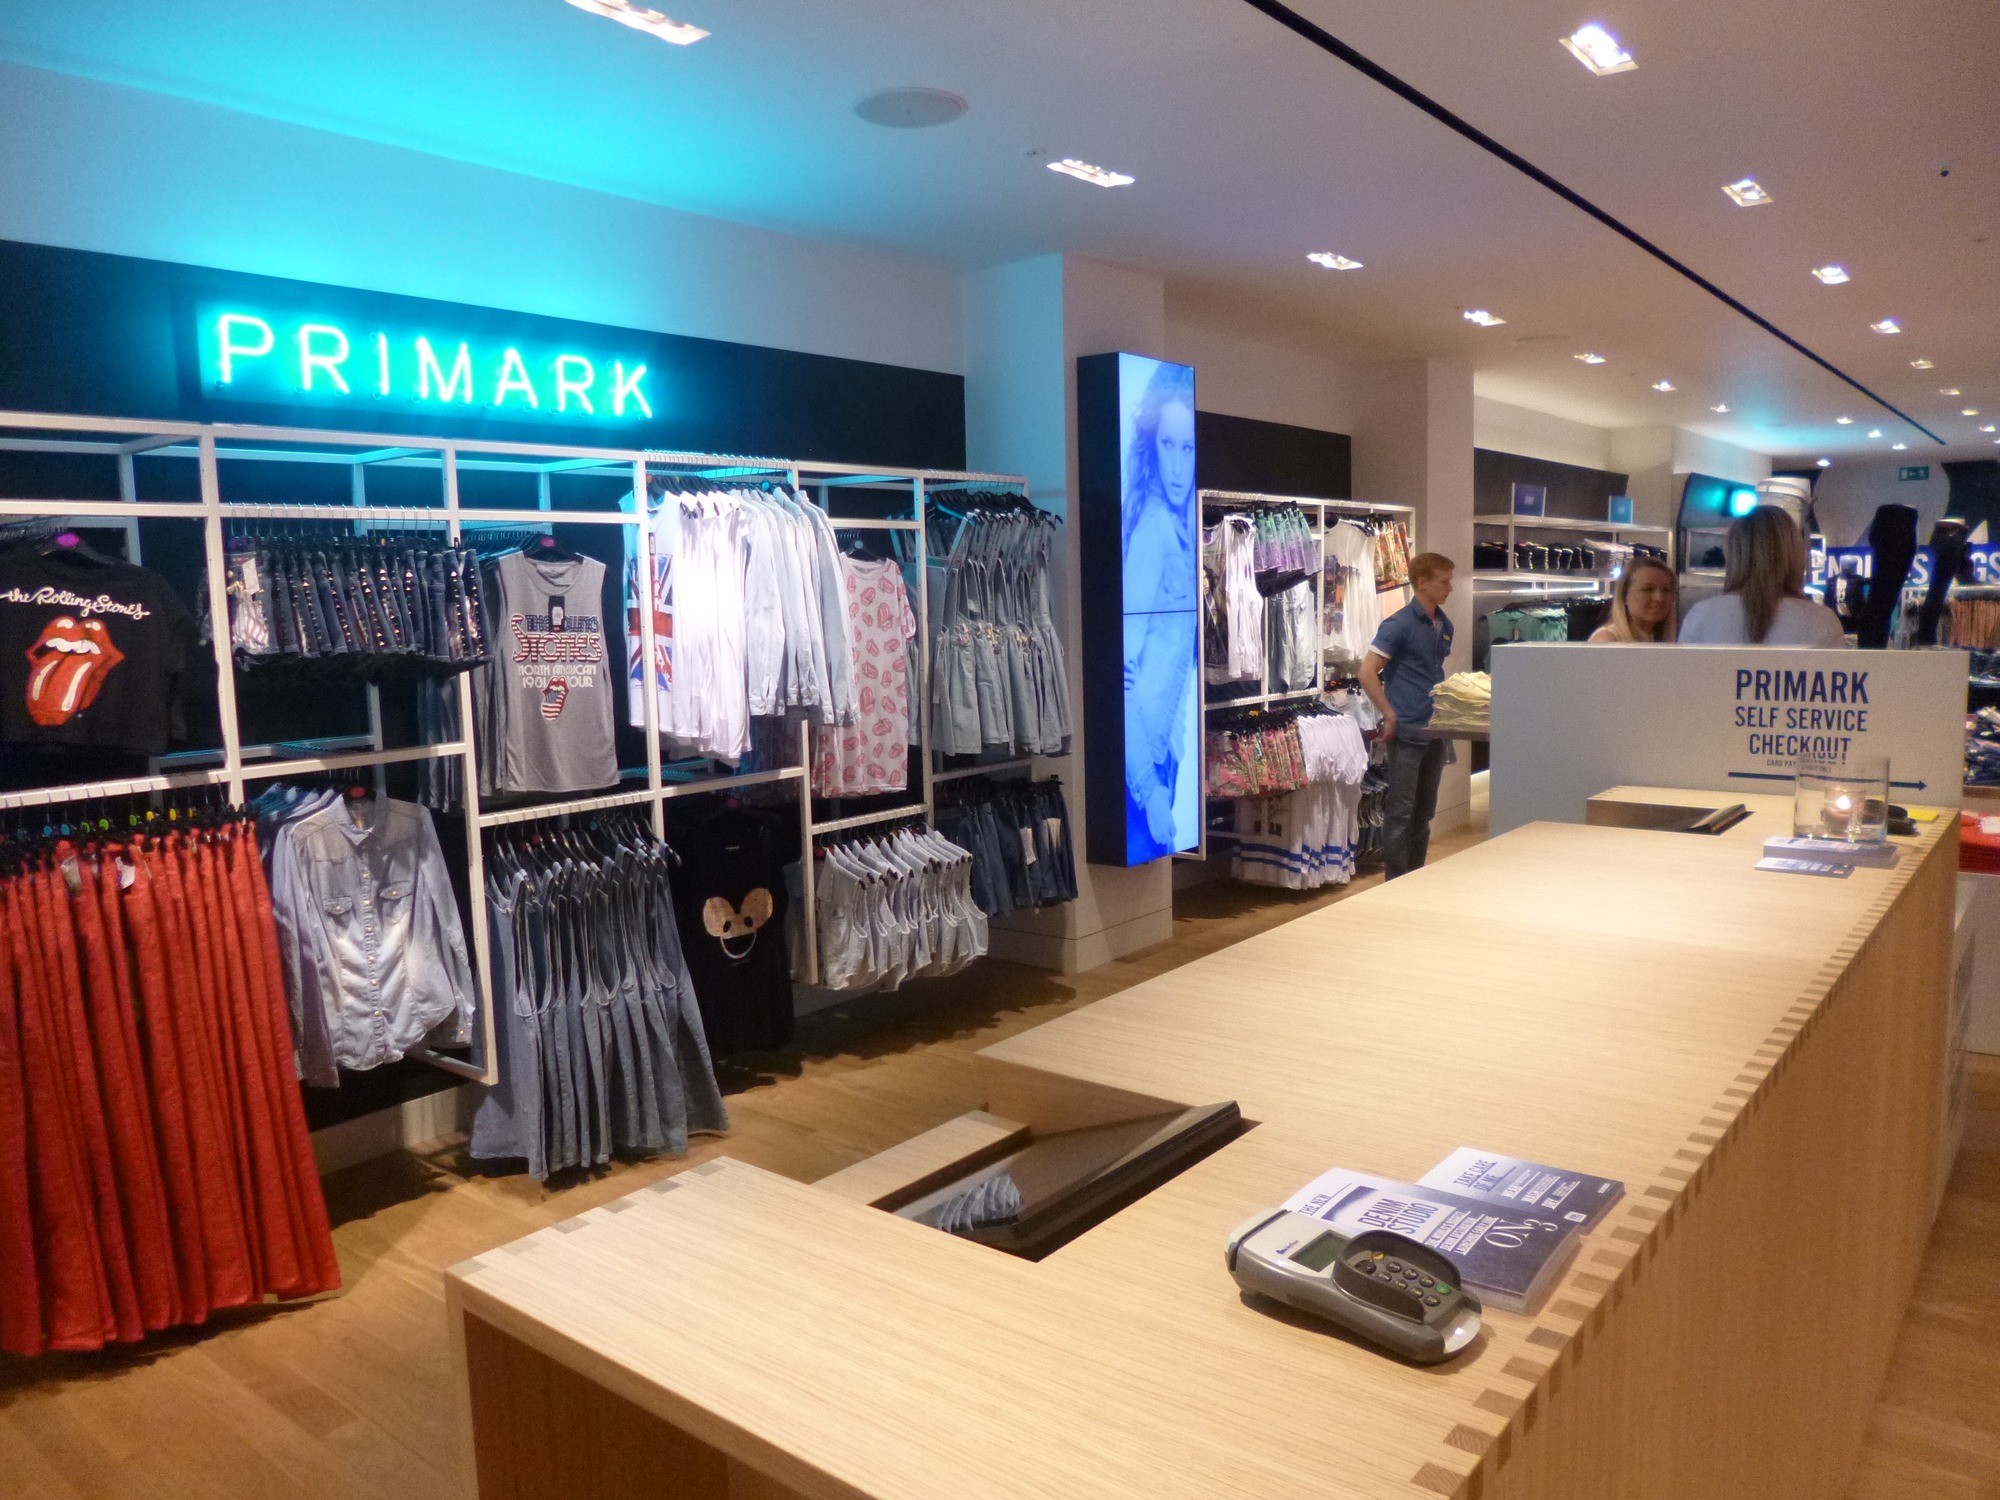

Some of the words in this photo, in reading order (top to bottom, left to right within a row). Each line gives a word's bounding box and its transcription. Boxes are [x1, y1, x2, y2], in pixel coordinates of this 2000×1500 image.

[217, 312, 653, 419] PRIMARK
[0, 587, 32, 603] the
[31, 587, 93, 618] Rolling
[93, 594, 151, 620] Stones
[511, 612, 603, 663] STONES
[518, 664, 550, 676] NORTH
[552, 664, 597, 676] AMERICAN
[522, 676, 547, 688] 1981
[1736, 669, 1869, 704] PRIMARK
[1735, 706, 1780, 727] SELF
[1786, 708, 1868, 732] SERVICE
[1749, 733, 1852, 757] CHECKOUT
[1452, 1171, 1480, 1186] TAKE
[1467, 1159, 1494, 1173] CARE
[1296, 1204, 1319, 1214] THE
[1308, 1193, 1332, 1205] NEW
[1355, 1197, 1408, 1227] DENIM
[1384, 1202, 1439, 1234] STUDIO
